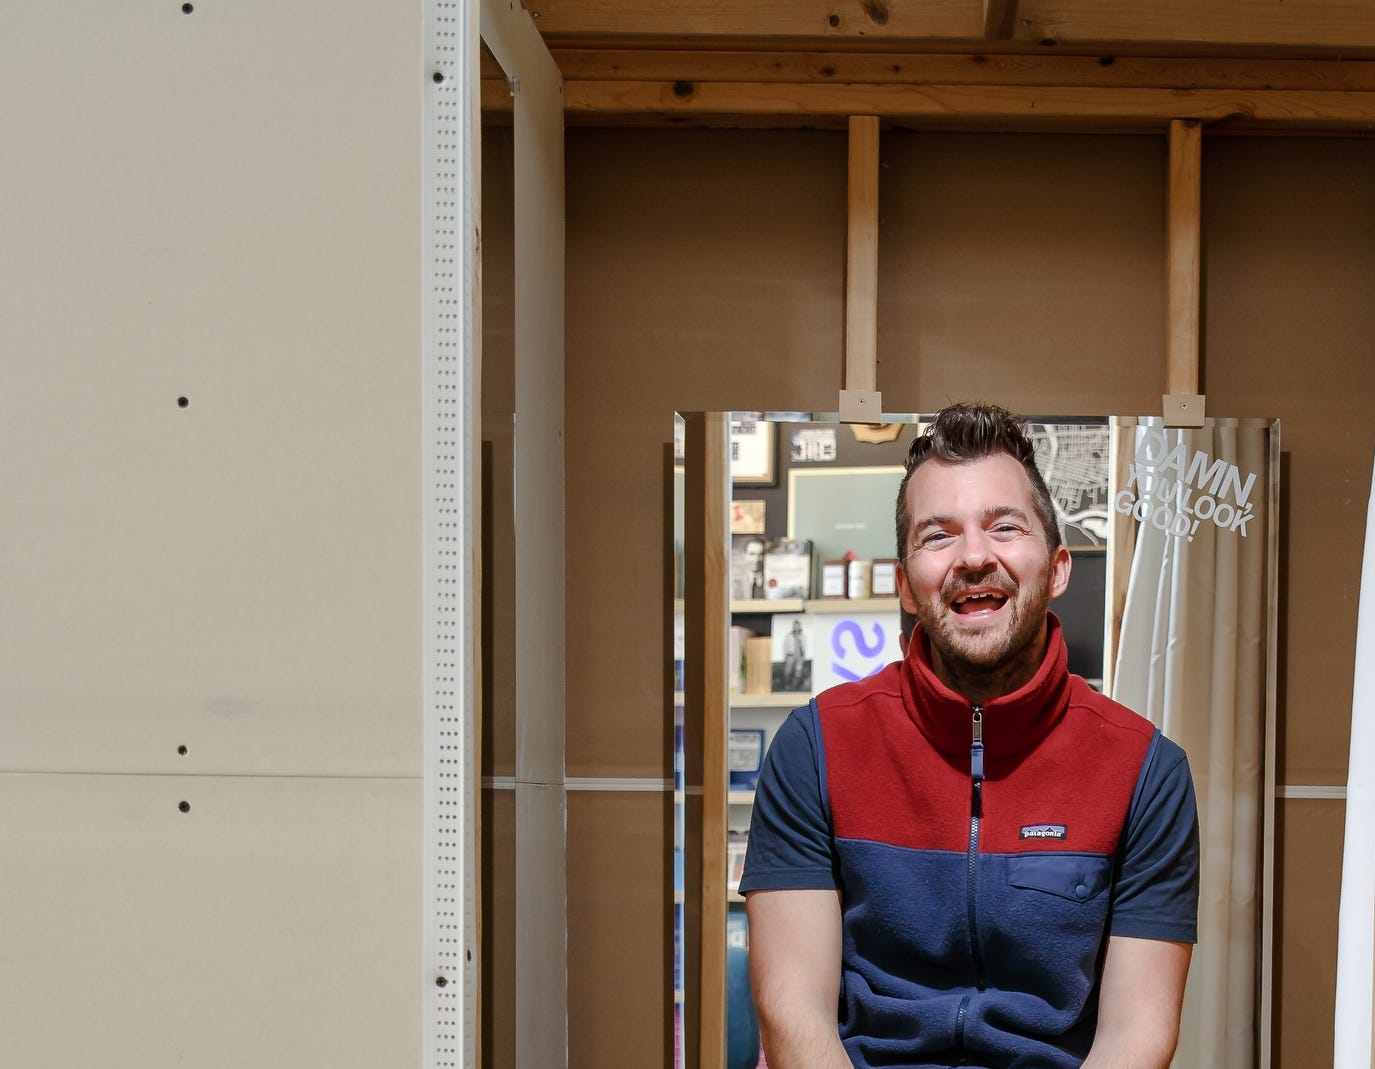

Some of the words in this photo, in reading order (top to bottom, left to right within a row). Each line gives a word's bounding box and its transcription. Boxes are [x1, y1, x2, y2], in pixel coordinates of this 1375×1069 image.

[1127, 463, 1178, 504] YOU
[1180, 488, 1254, 538] LOOK
[1134, 430, 1257, 515] DAMN,
[1114, 490, 1200, 543] GOOD!
